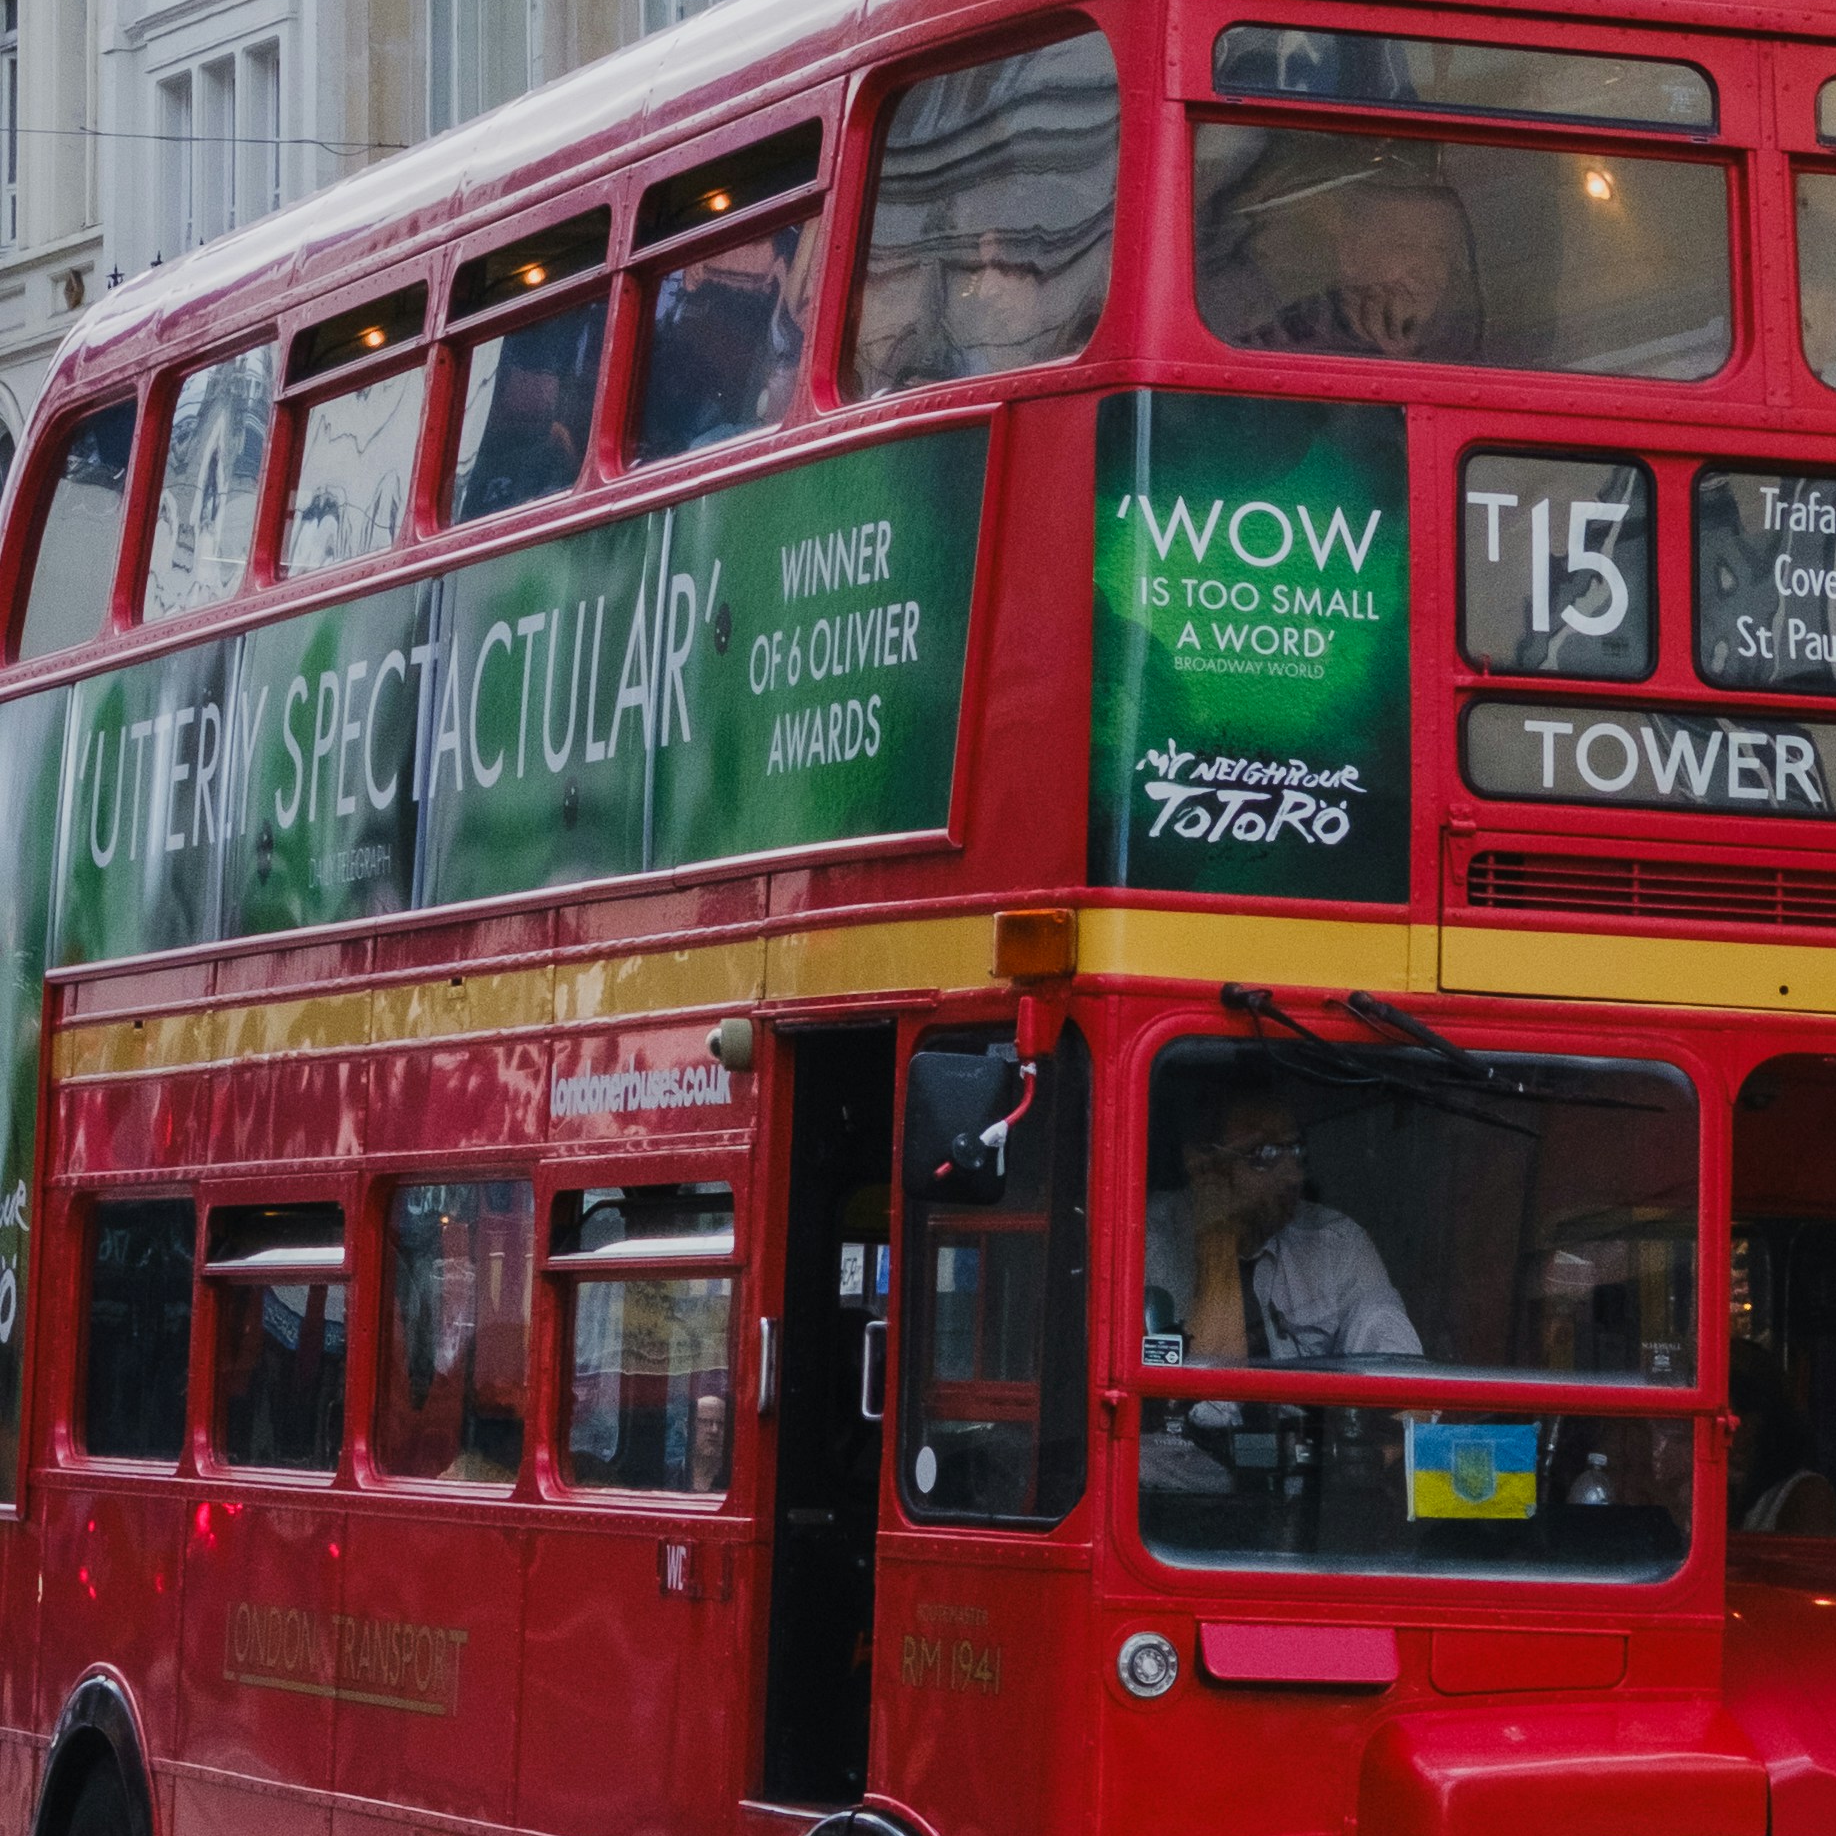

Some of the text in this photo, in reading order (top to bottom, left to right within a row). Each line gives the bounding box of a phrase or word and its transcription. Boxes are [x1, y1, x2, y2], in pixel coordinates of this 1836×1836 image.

[782, 521, 891, 604] WINNER
[1142, 577, 1380, 621] IS TOO SMALL
[750, 601, 920, 694] OF 6 OLIVIER
[1177, 622, 1202, 650] A
[1737, 616, 1774, 660] St
[1174, 656, 1325, 679] BROADWAY WORLD
[766, 694, 882, 776] AWARDS
[1524, 721, 1821, 802] TOWER
[337, 843, 392, 883] TELEGRAPH
[223, 1601, 468, 1717] LONDON TRANSPORT
[902, 1635, 1001, 1695] RM 1941
